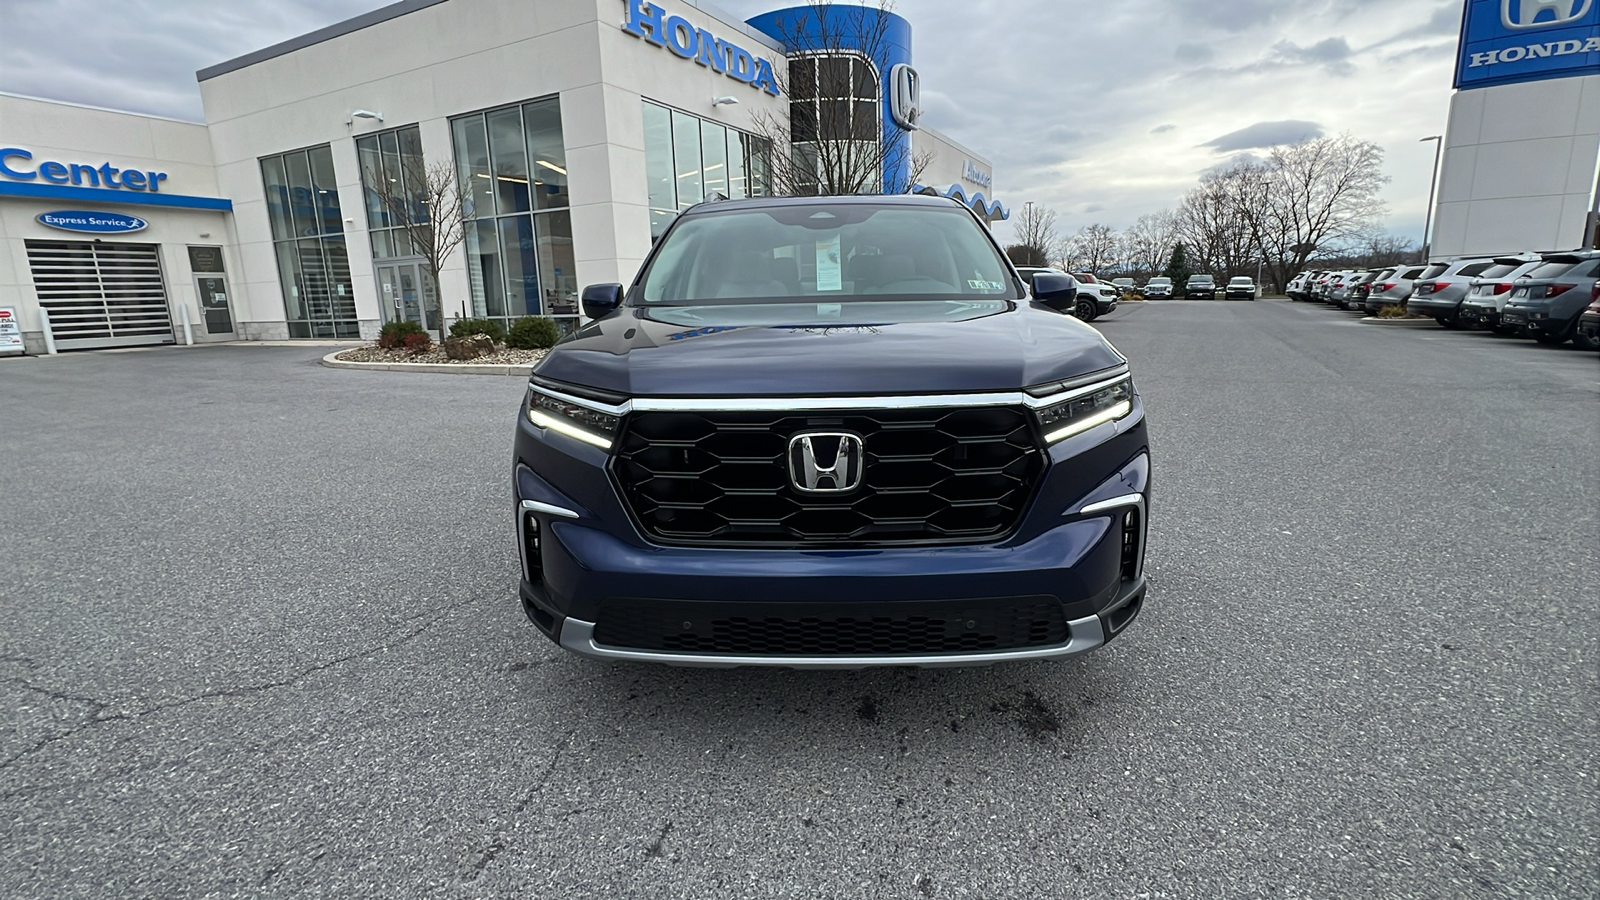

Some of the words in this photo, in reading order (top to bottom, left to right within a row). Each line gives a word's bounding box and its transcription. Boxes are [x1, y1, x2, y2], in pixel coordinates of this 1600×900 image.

[621, 0, 780, 97] HONDA
[1469, 37, 1600, 68] HONDA
[0, 148, 168, 192] Center
[44, 215, 87, 226] Express
[88, 217, 126, 227] Service
